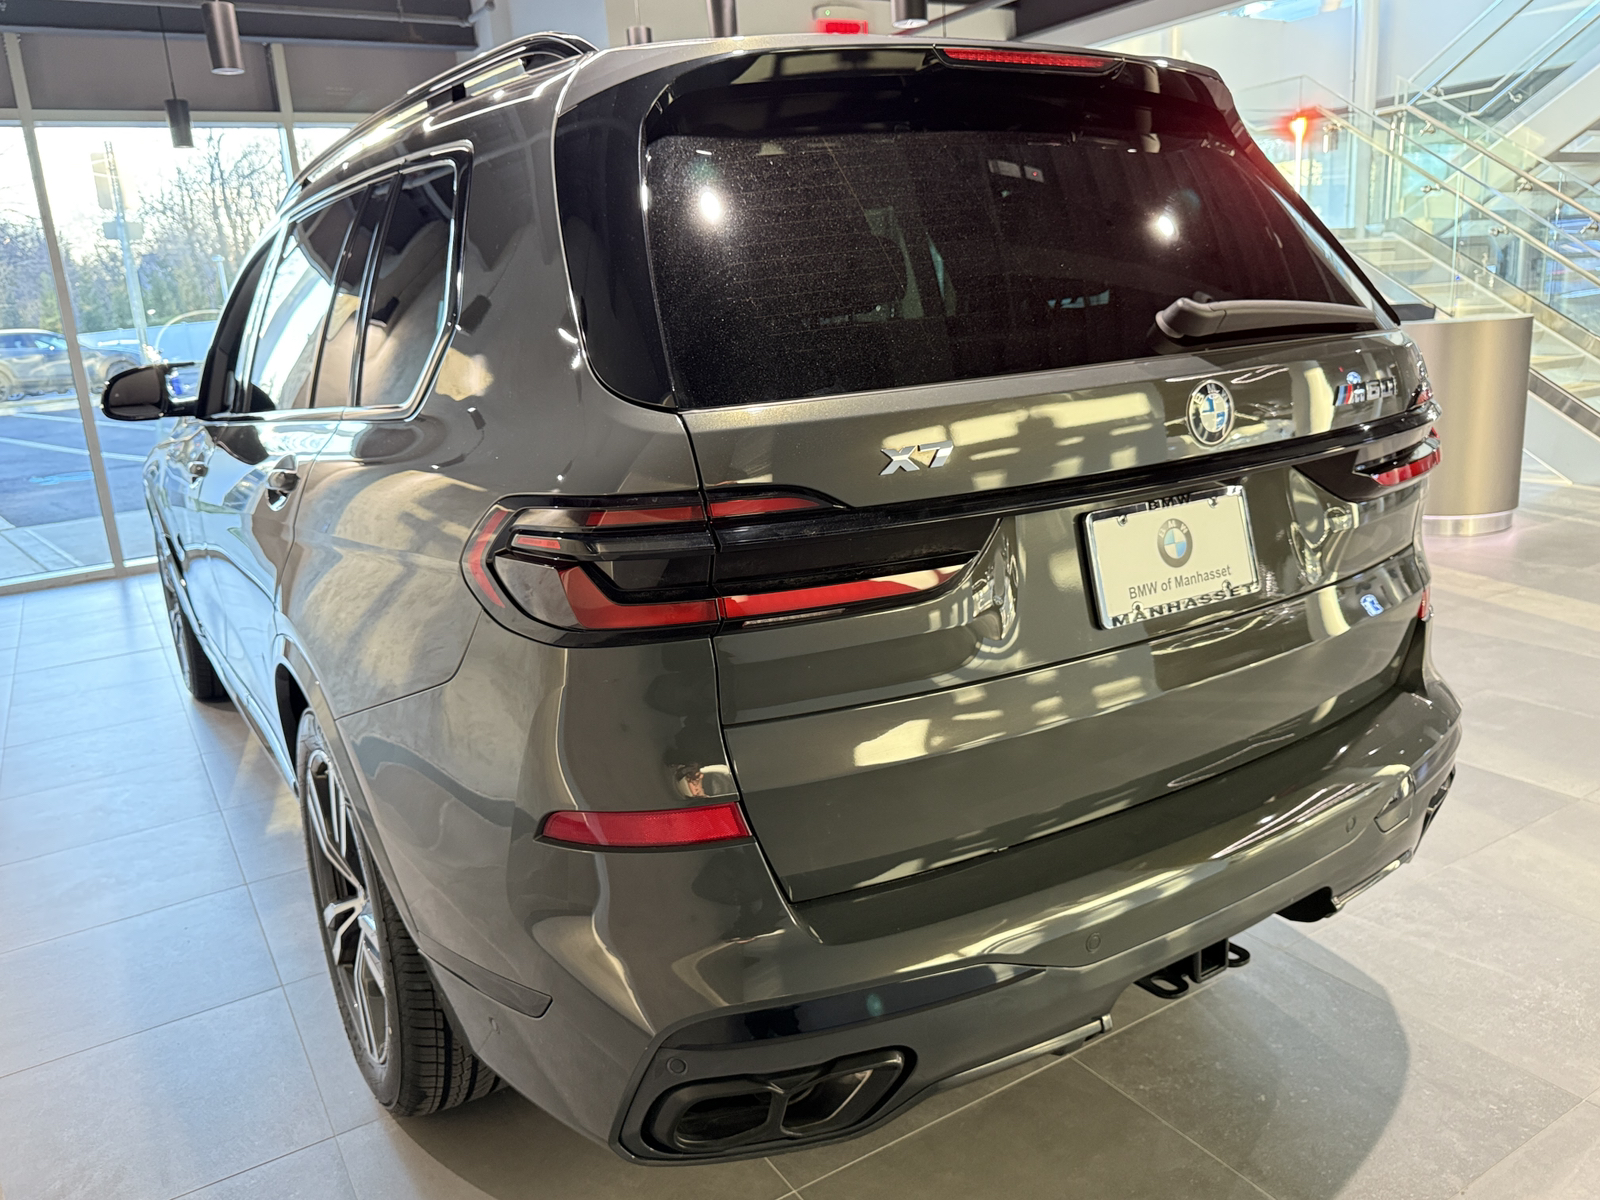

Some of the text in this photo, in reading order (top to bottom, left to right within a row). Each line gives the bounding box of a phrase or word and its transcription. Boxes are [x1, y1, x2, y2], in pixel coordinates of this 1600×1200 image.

[878, 440, 954, 476] X7
[1148, 494, 1192, 511] BMW
[1158, 520, 1188, 538] BMW
[1128, 565, 1232, 600] BMW of Manhasset
[1111, 584, 1256, 627] MANHASSET
